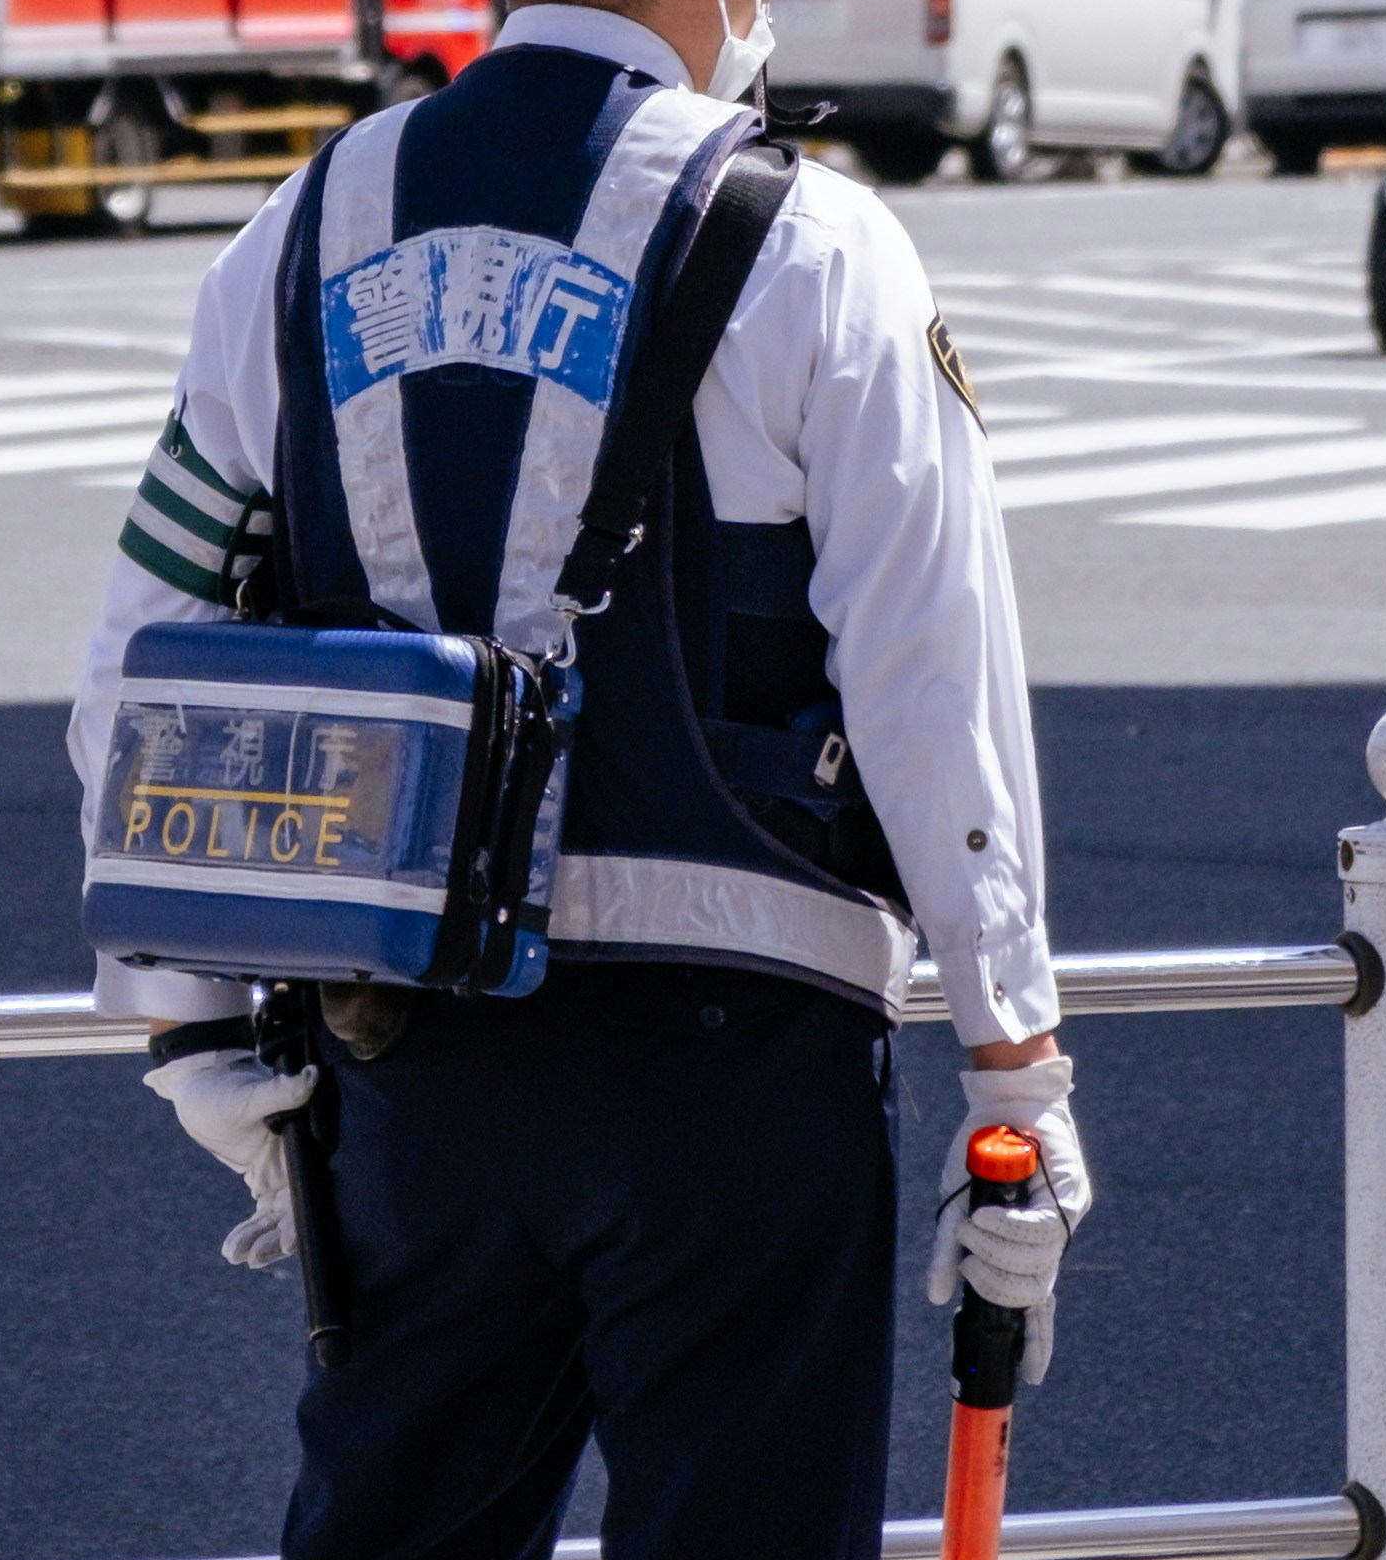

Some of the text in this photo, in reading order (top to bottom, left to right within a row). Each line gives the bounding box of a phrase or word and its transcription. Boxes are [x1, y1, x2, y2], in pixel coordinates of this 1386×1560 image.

[137, 708, 359, 792] 警視庁
[123, 800, 349, 868] POLICE
